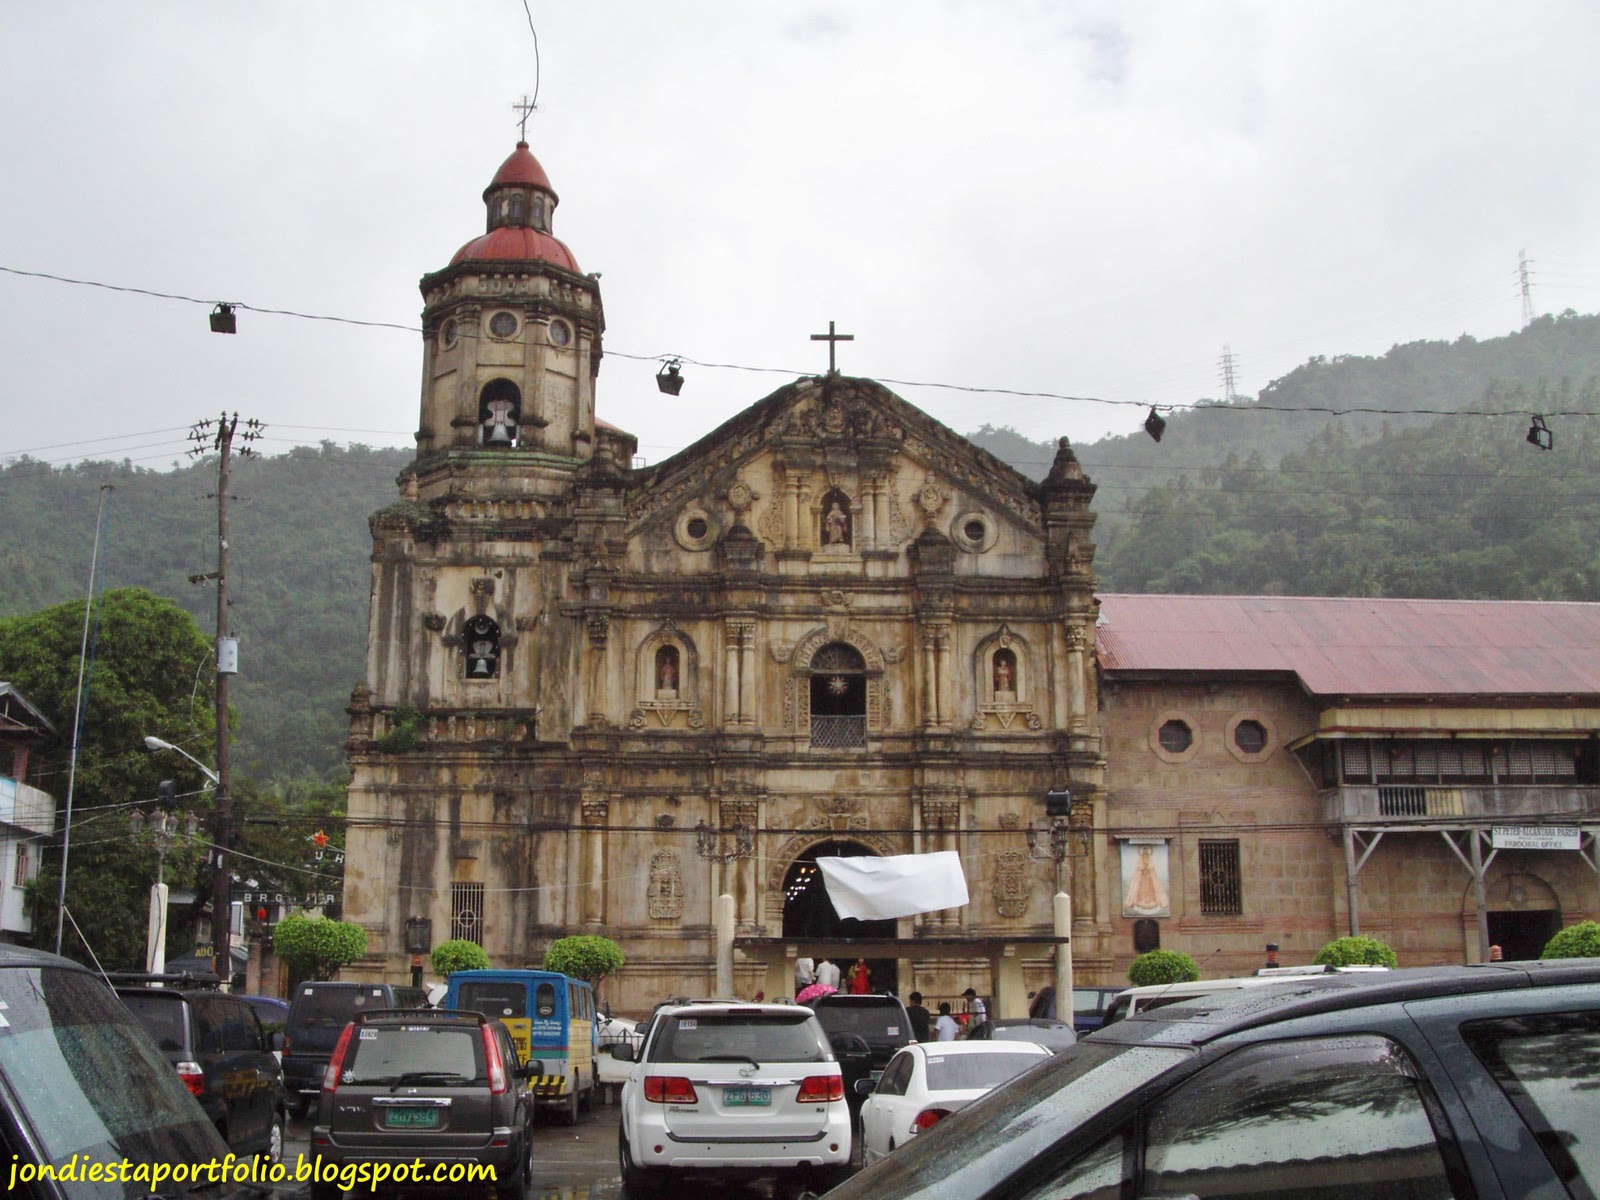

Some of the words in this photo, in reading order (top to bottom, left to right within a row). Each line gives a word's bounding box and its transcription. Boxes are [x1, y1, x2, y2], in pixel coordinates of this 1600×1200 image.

[1557, 827, 1579, 837] PARISH
[1504, 840, 1540, 848] PAROCHIAL
[1541, 841, 1563, 849] OFFICE
